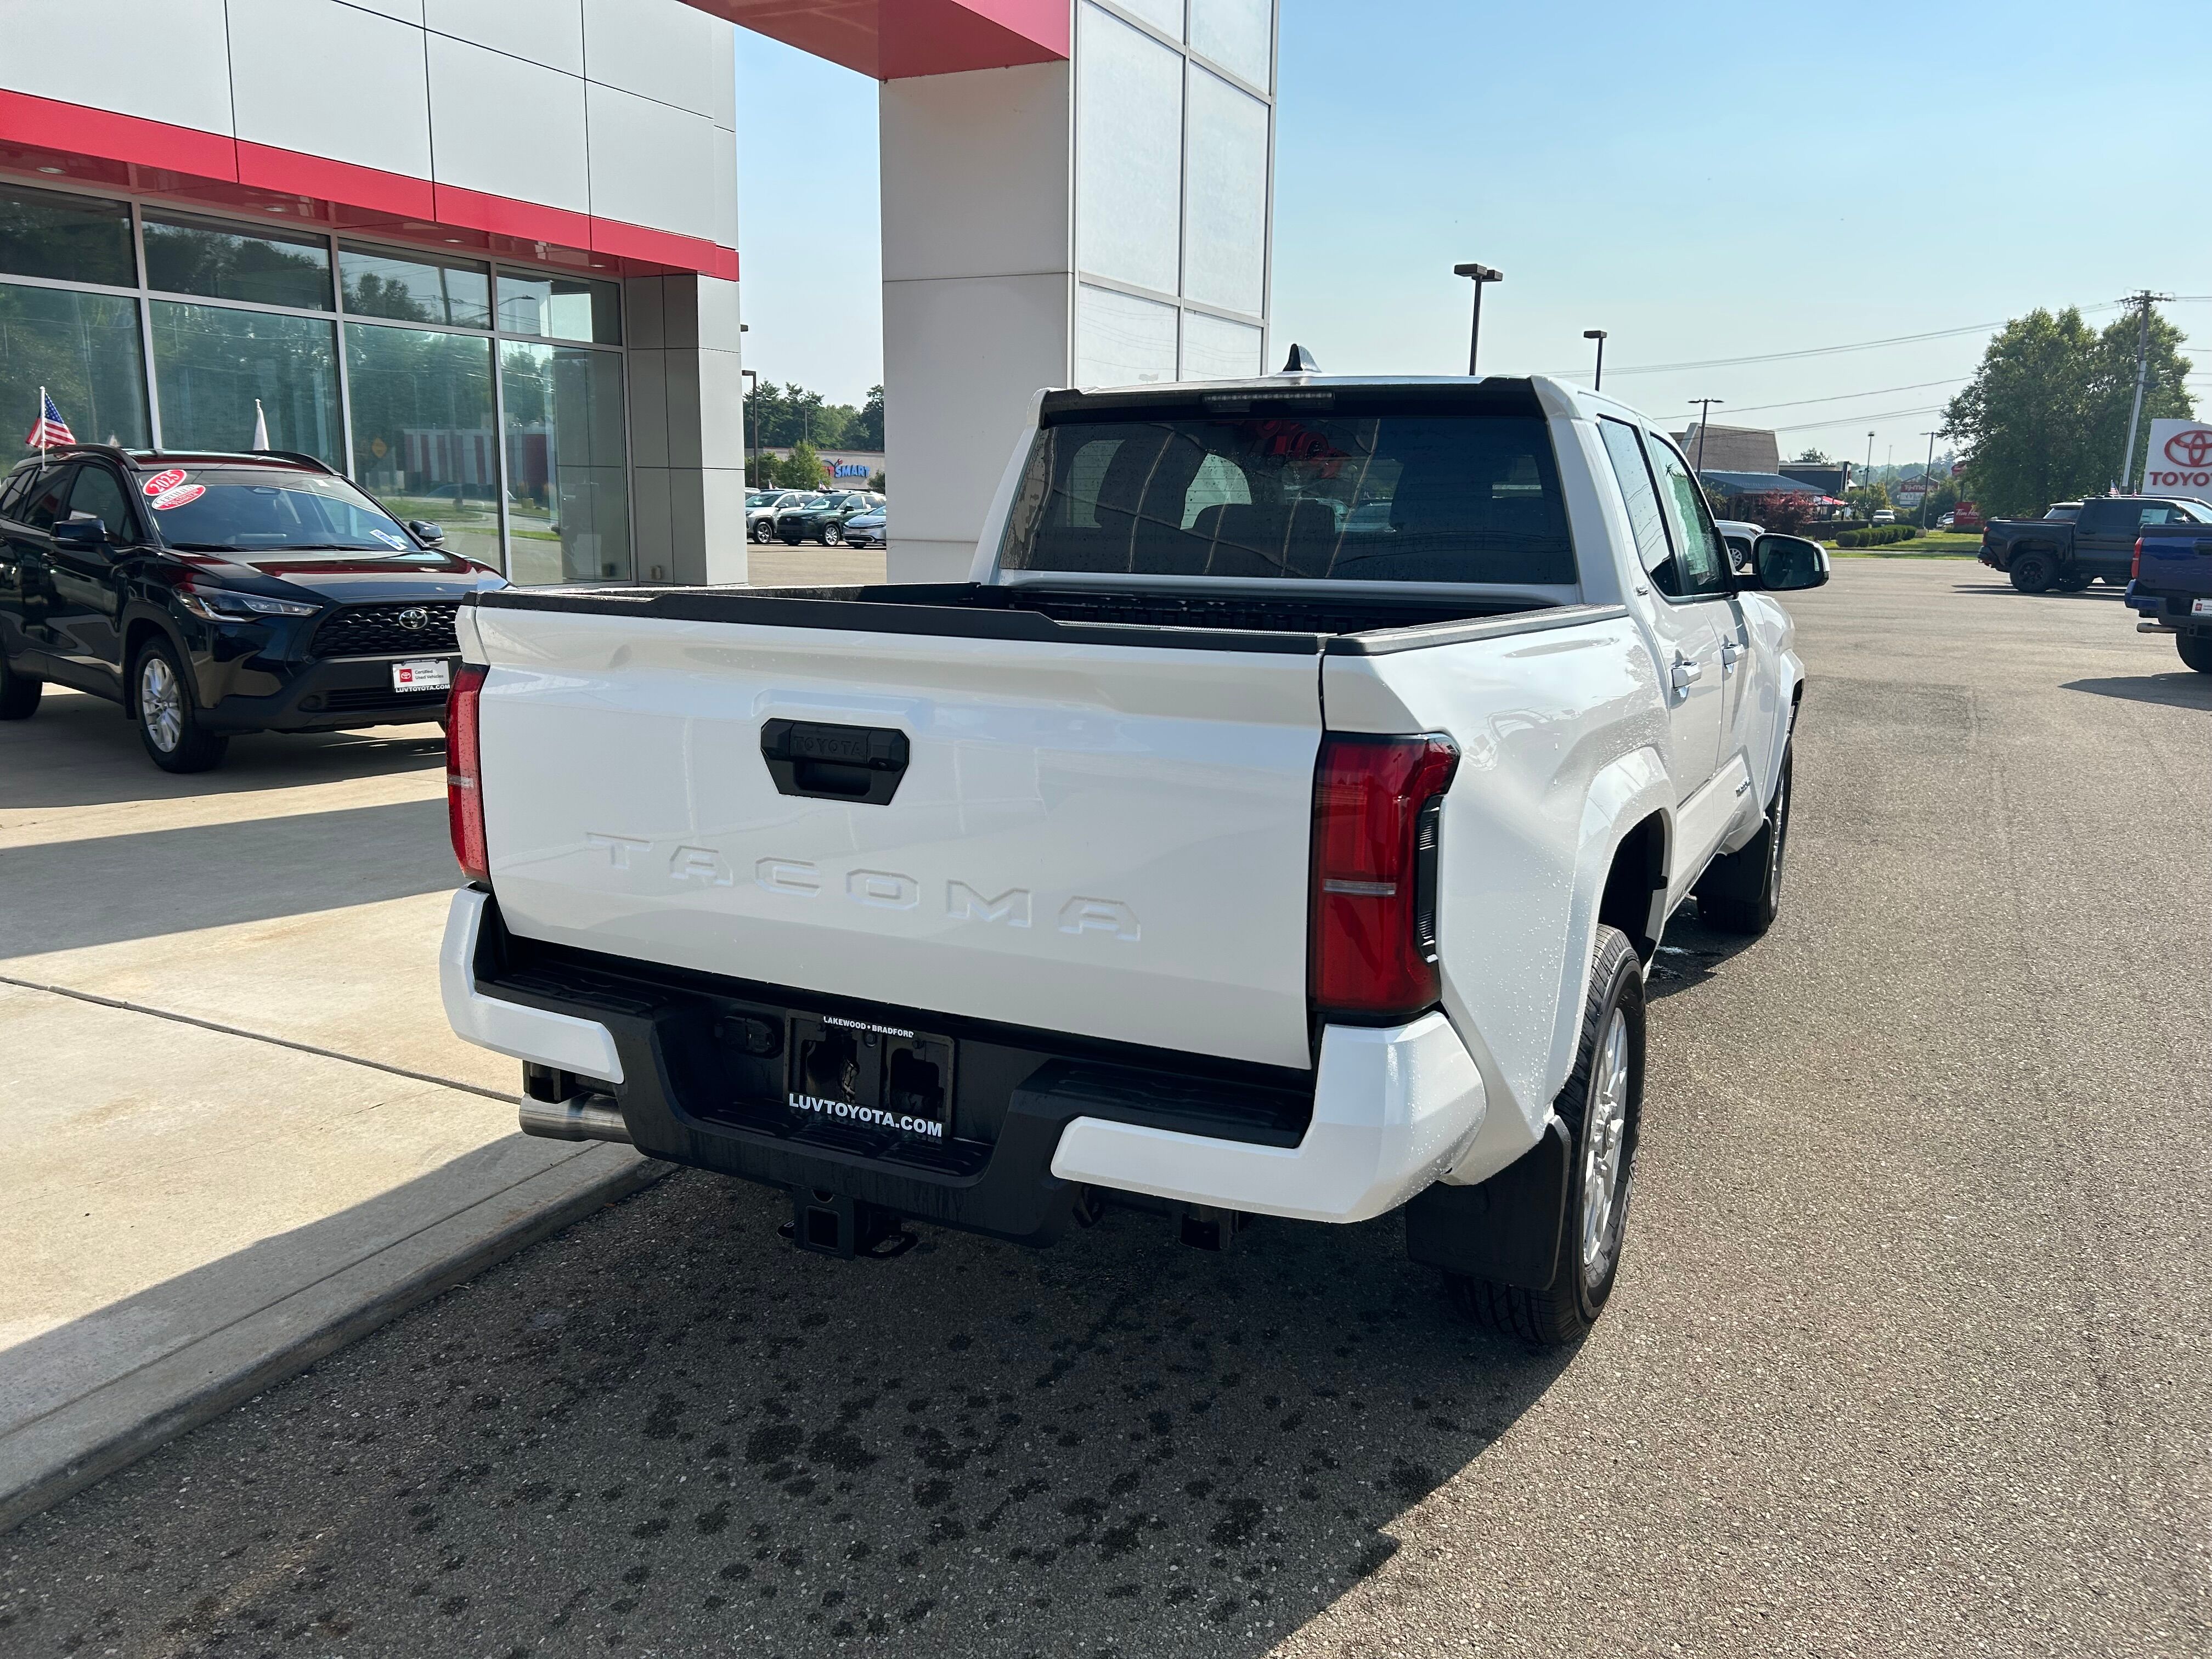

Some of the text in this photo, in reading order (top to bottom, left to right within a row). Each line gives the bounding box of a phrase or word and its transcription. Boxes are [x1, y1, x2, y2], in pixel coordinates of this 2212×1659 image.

[150, 471, 179, 492] 2025
[2149, 471, 2212, 487] TOYO
[396, 684, 450, 693] LUVTOYOTA.COM
[794, 736, 863, 757] TOYOTA
[586, 832, 1142, 942] TACOMA
[823, 1015, 914, 1038] LAKEWOOD BRADFORD
[789, 1093, 942, 1137] LUVTOYOTA.COM
